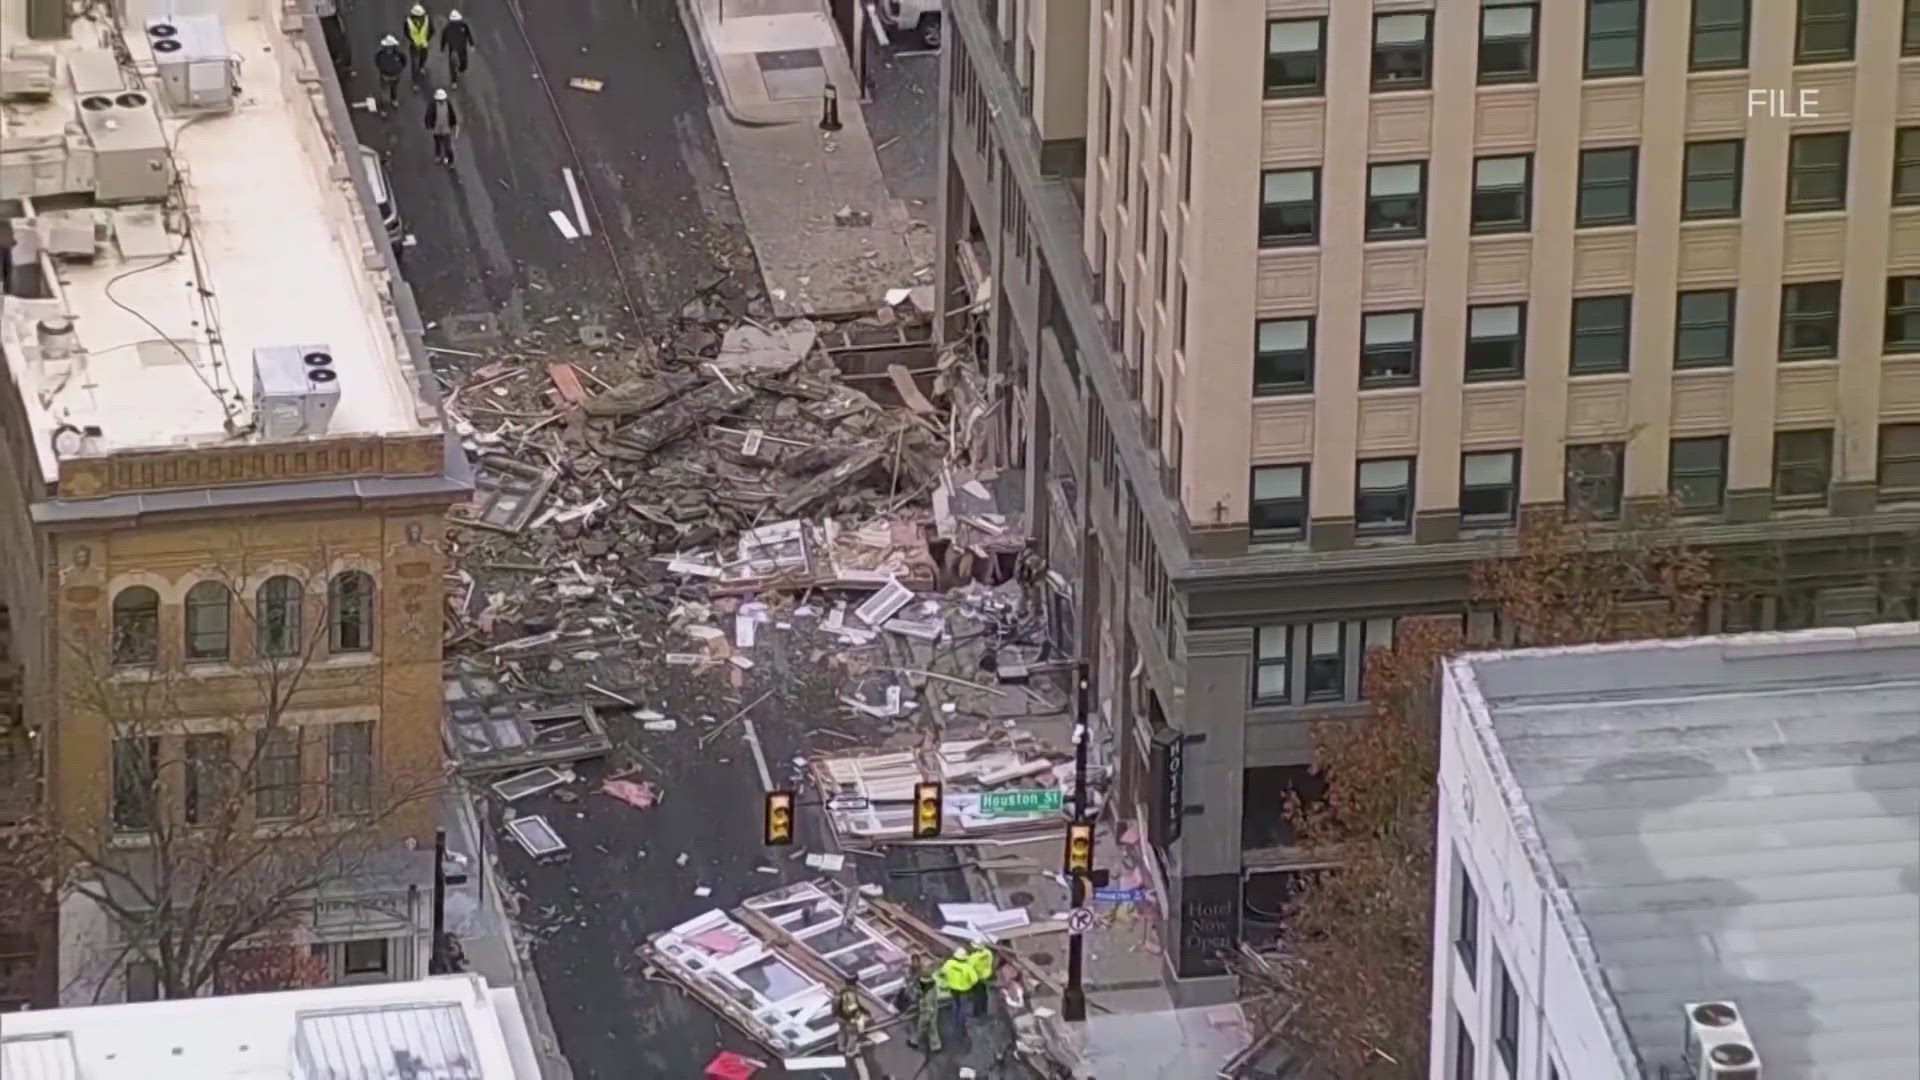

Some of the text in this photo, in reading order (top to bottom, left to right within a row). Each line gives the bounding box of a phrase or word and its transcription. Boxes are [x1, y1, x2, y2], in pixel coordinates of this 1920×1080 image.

[983, 791, 1058, 808] Houston St
[1189, 902, 1232, 917] Hotel
[1191, 920, 1226, 932] Now
